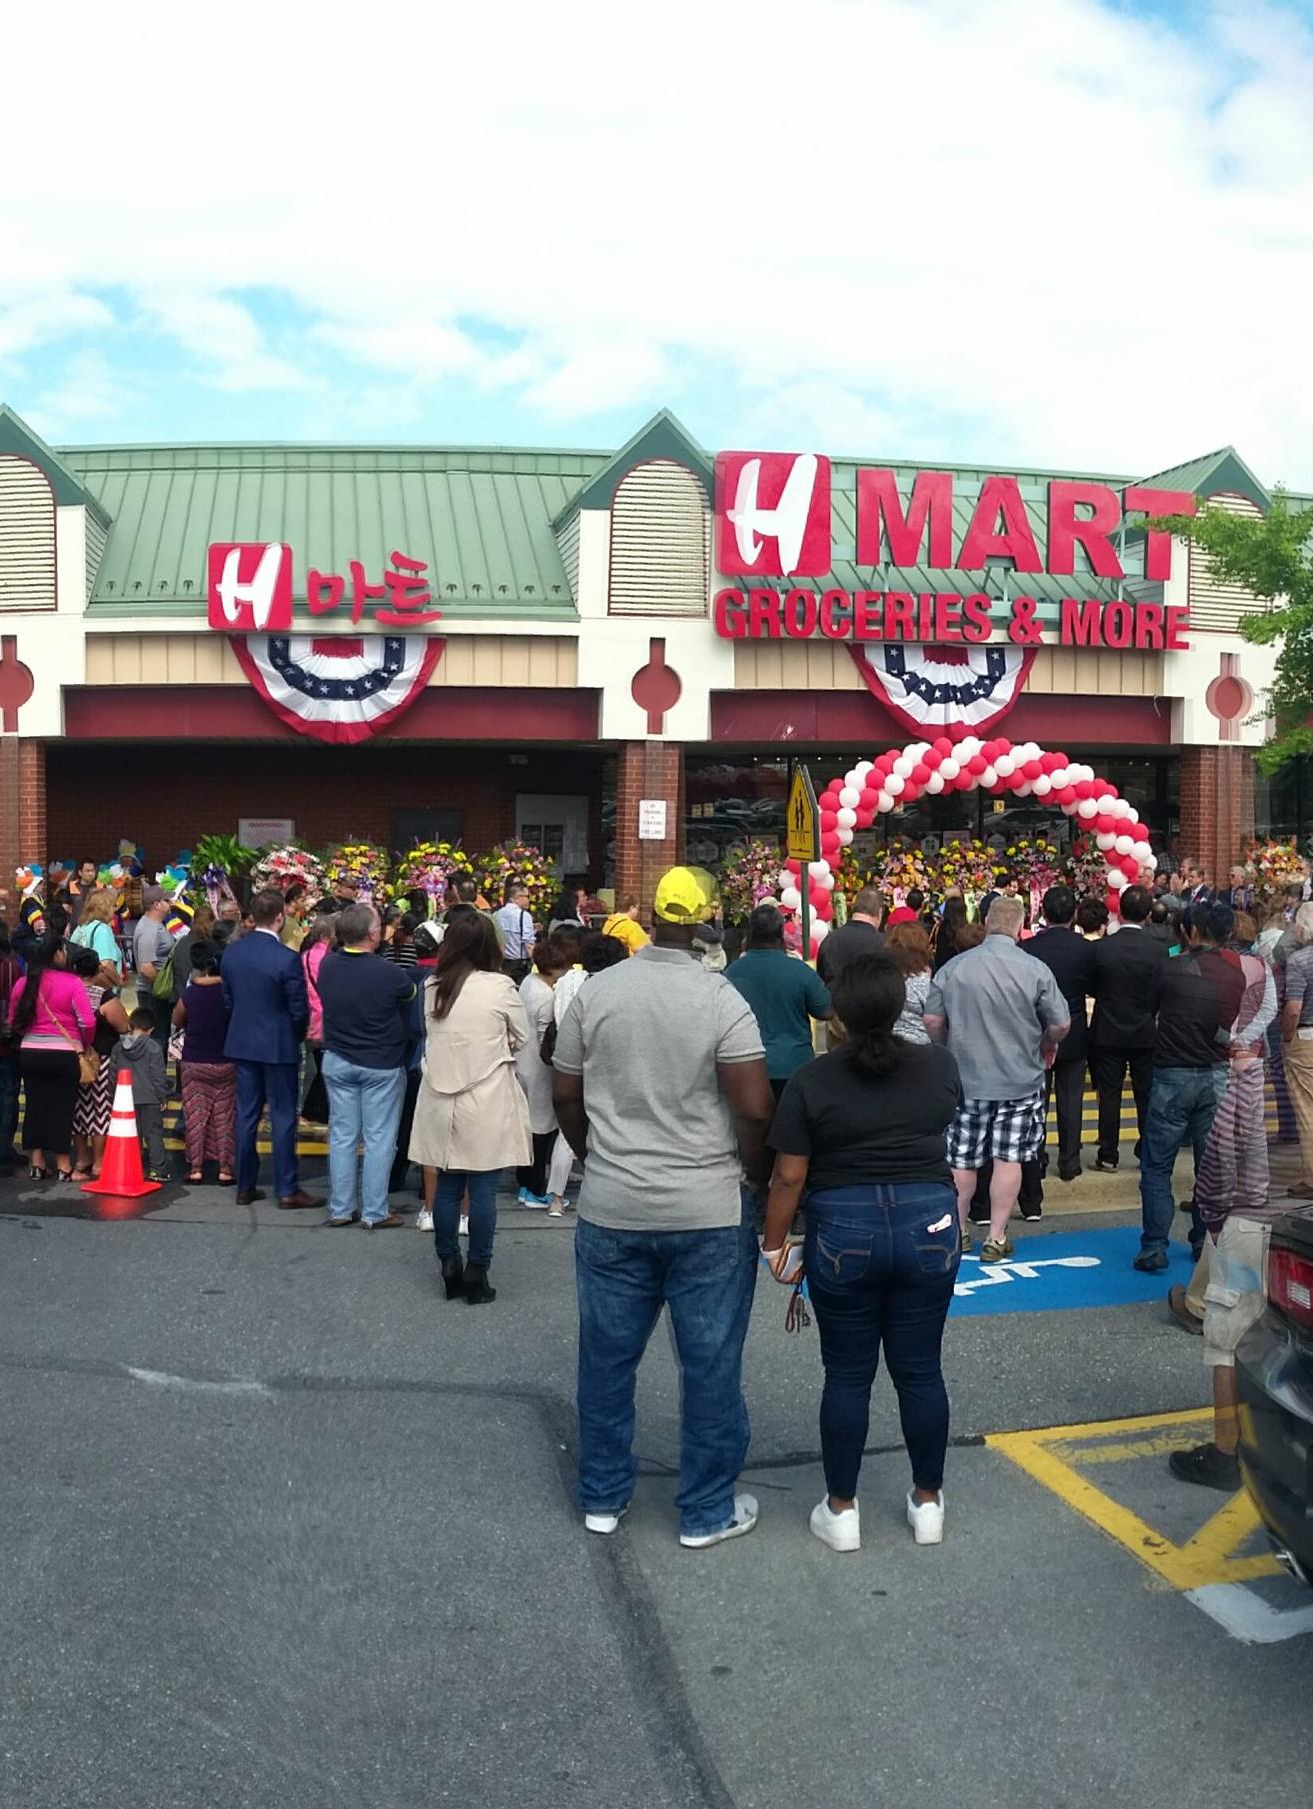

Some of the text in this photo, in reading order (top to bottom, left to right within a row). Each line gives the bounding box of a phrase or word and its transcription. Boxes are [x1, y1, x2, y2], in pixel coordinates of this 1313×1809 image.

[725, 453, 1197, 581] H MART
[306, 550, 444, 627] 마트
[714, 587, 1191, 650] GROCERIES & MORE
